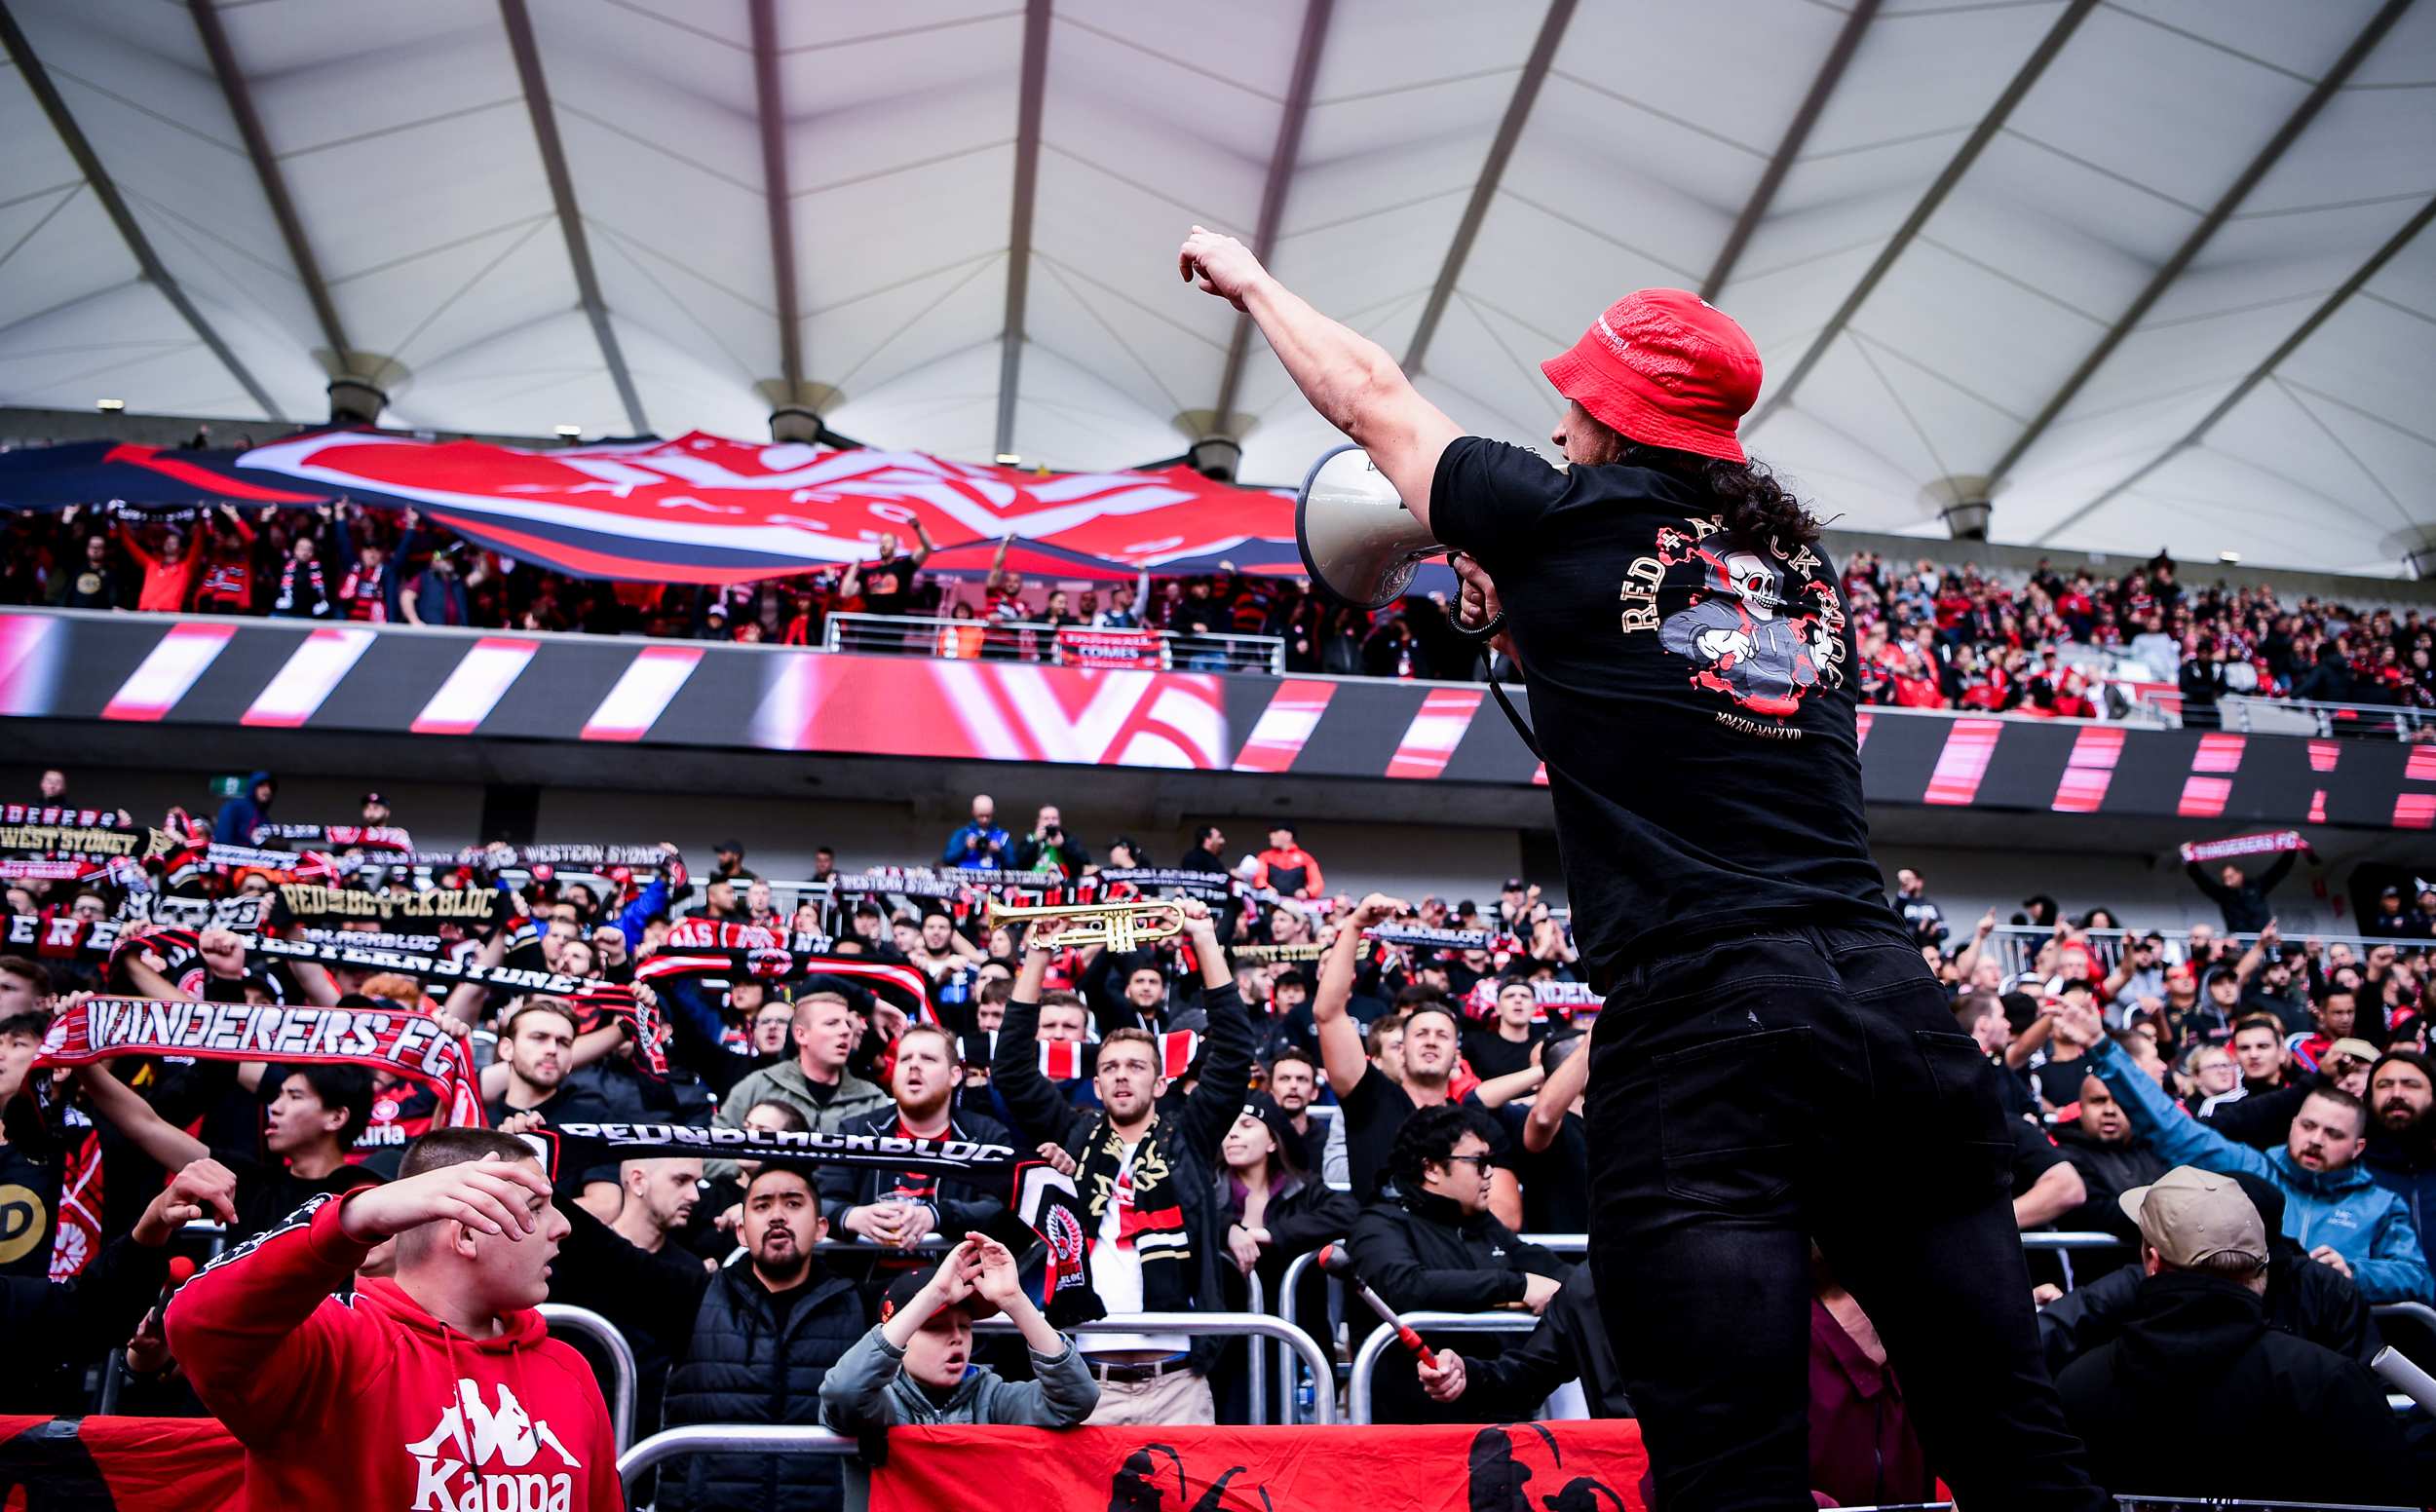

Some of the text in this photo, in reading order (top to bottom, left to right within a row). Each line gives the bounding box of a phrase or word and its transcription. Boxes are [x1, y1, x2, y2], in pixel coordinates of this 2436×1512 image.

[1620, 556, 1666, 634] RED
[523, 845, 605, 864] WESTERN
[436, 888, 499, 918] BLOC
[87, 1000, 461, 1078] WANDERERS FC
[410, 1455, 572, 1512] Kappa
